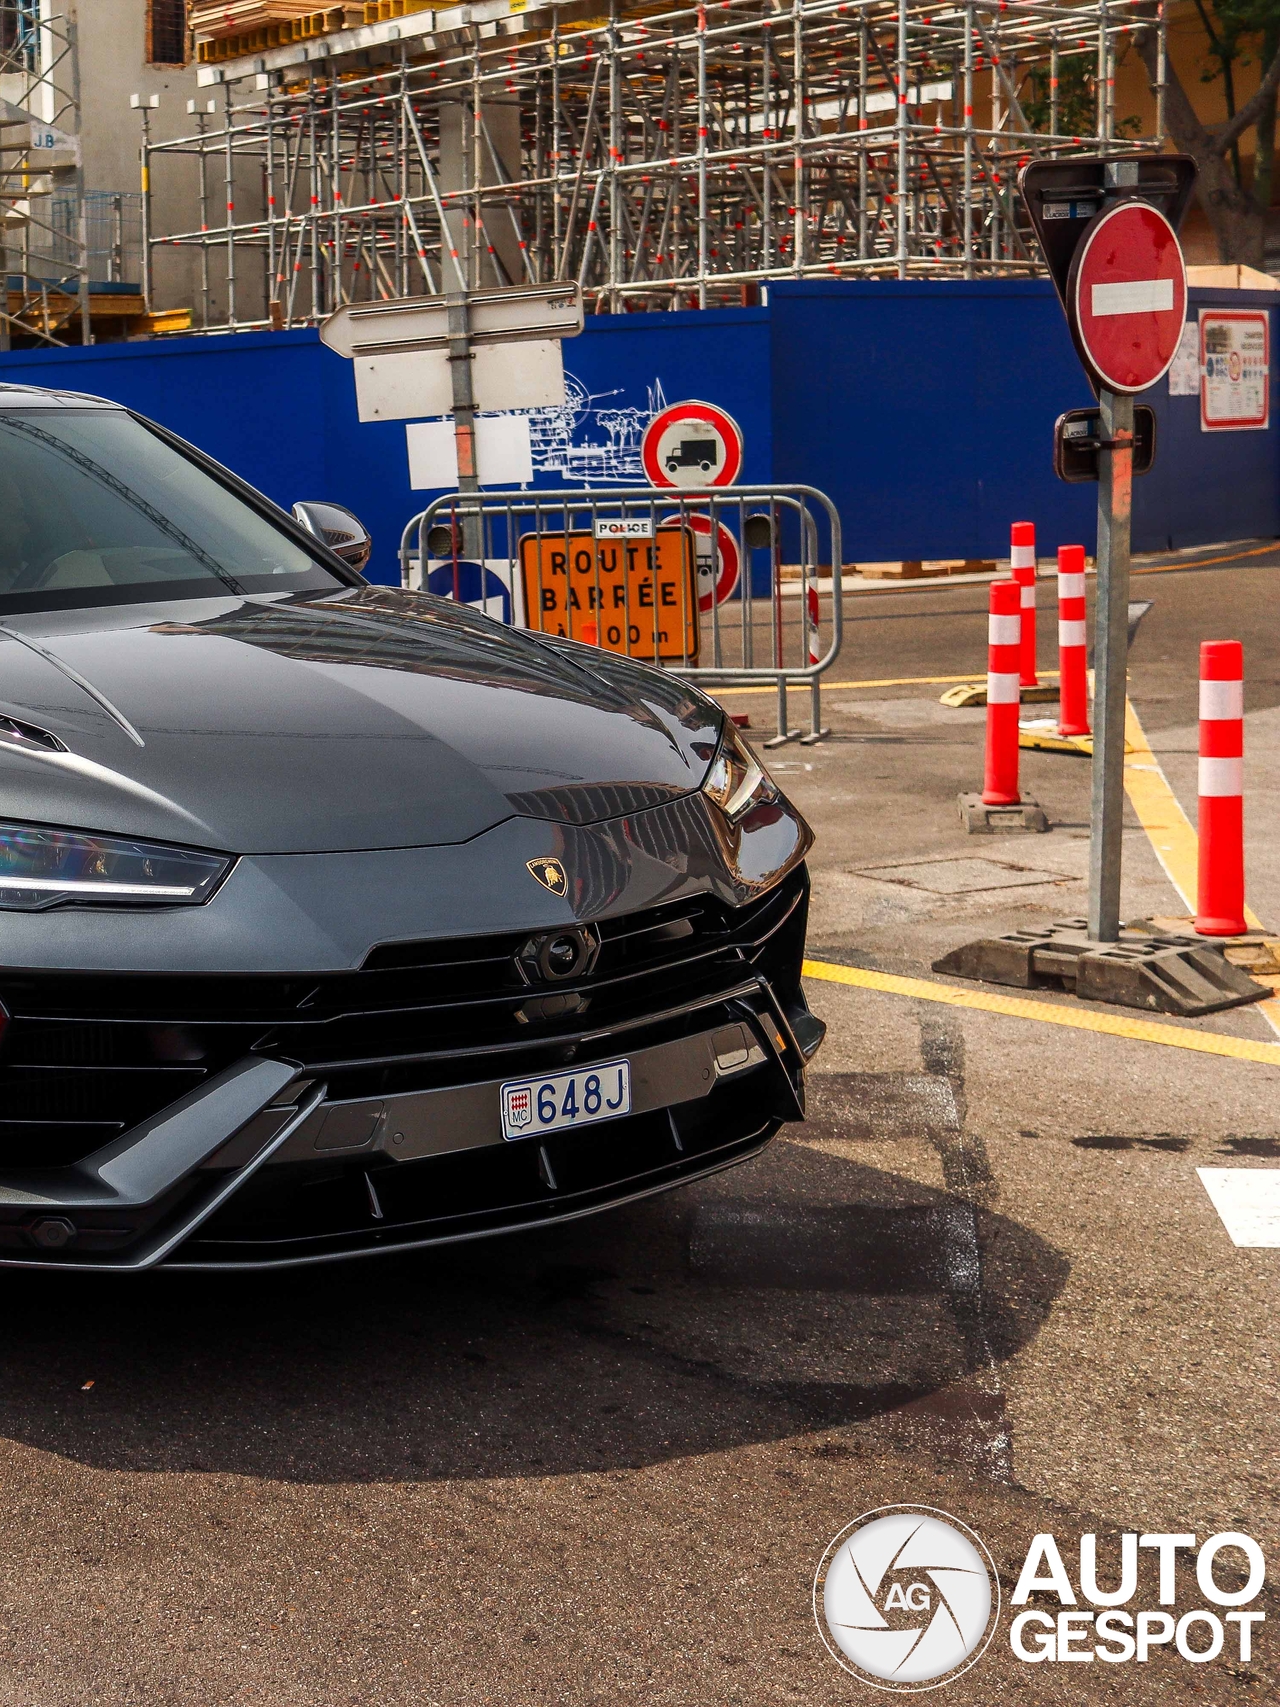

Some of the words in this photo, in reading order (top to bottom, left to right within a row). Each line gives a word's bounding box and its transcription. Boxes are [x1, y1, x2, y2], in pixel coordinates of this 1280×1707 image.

[599, 523, 649, 534] POLICE
[550, 546, 662, 575] ROUTE
[540, 577, 677, 611] BARRÉE
[607, 625, 640, 645] 00
[512, 1109, 528, 1123] MC
[537, 1068, 623, 1124] 648J
